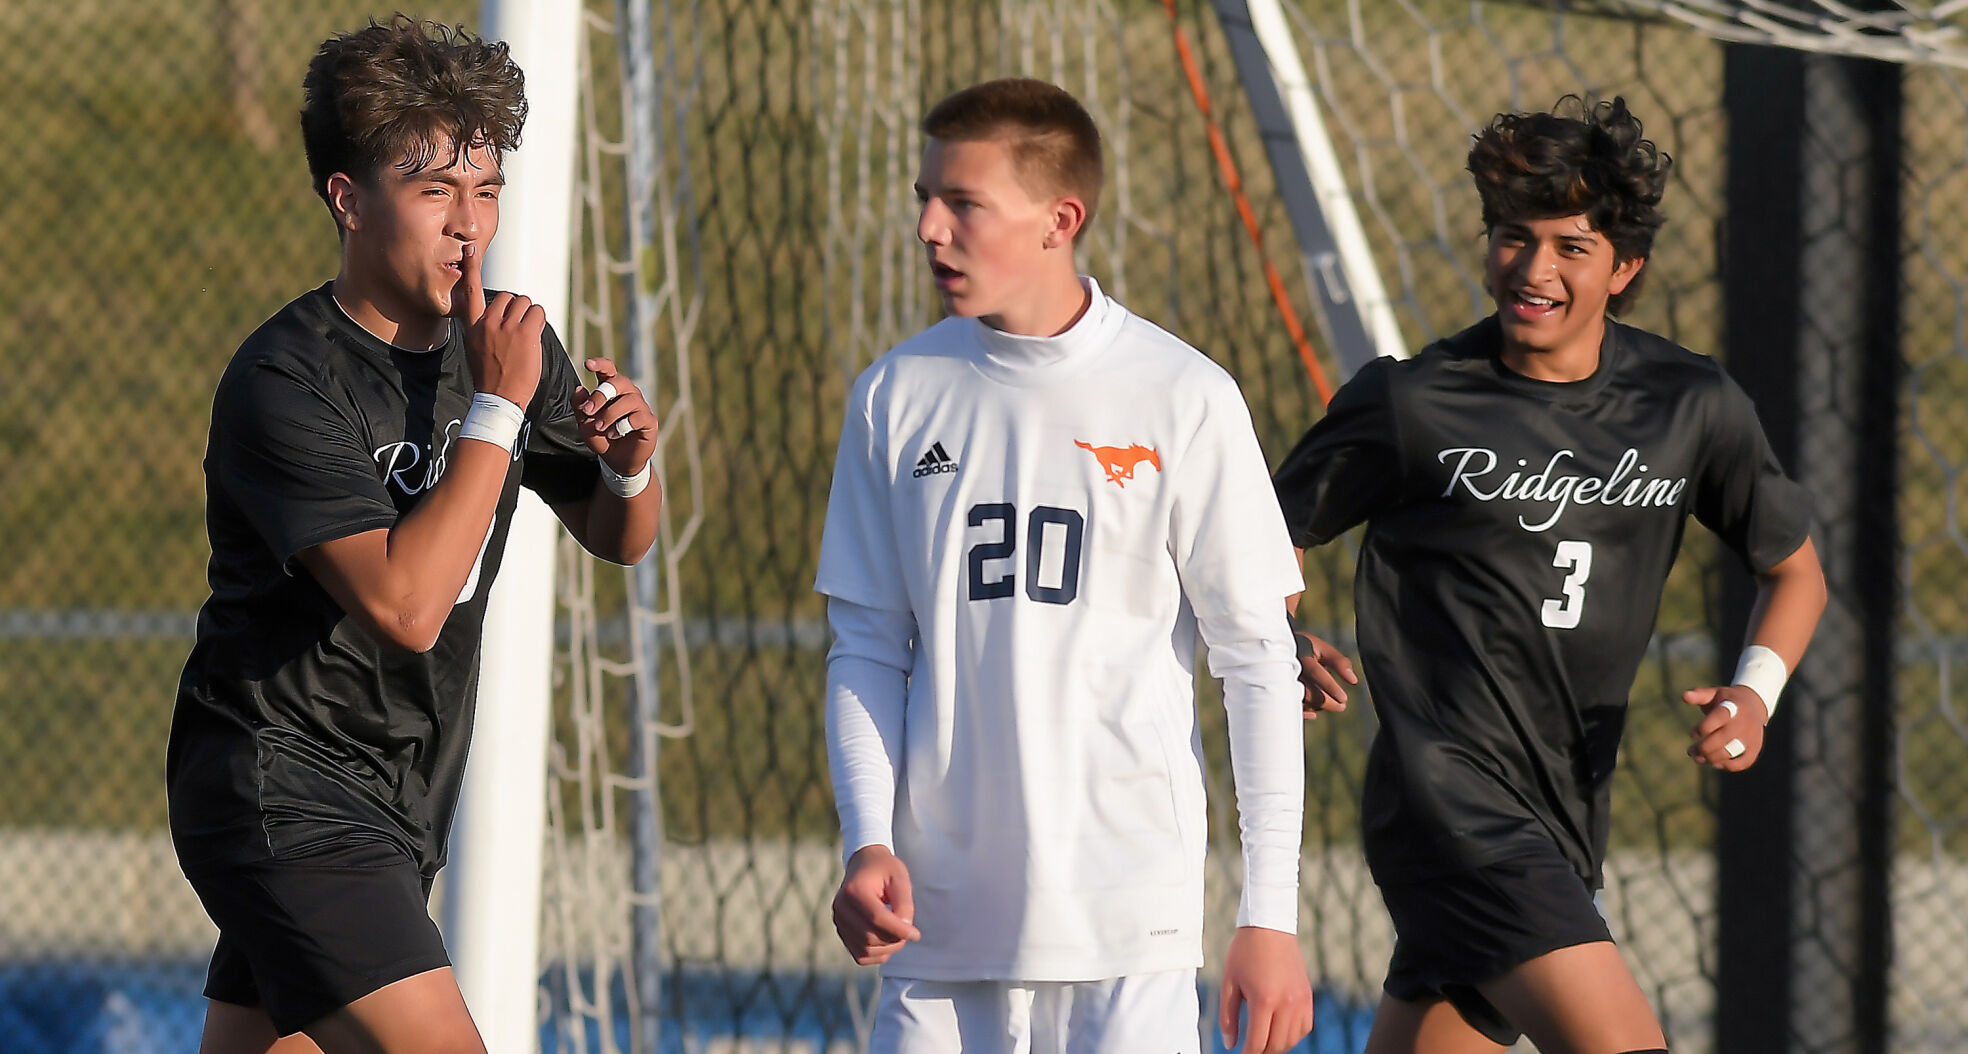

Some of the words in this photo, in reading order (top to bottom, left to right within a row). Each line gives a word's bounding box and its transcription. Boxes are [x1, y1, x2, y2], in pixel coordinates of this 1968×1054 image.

[912, 461, 958, 478] adidas
[1437, 447, 1687, 532] Ridgeline
[968, 502, 1084, 605] 20
[1541, 540, 1592, 629] 3
